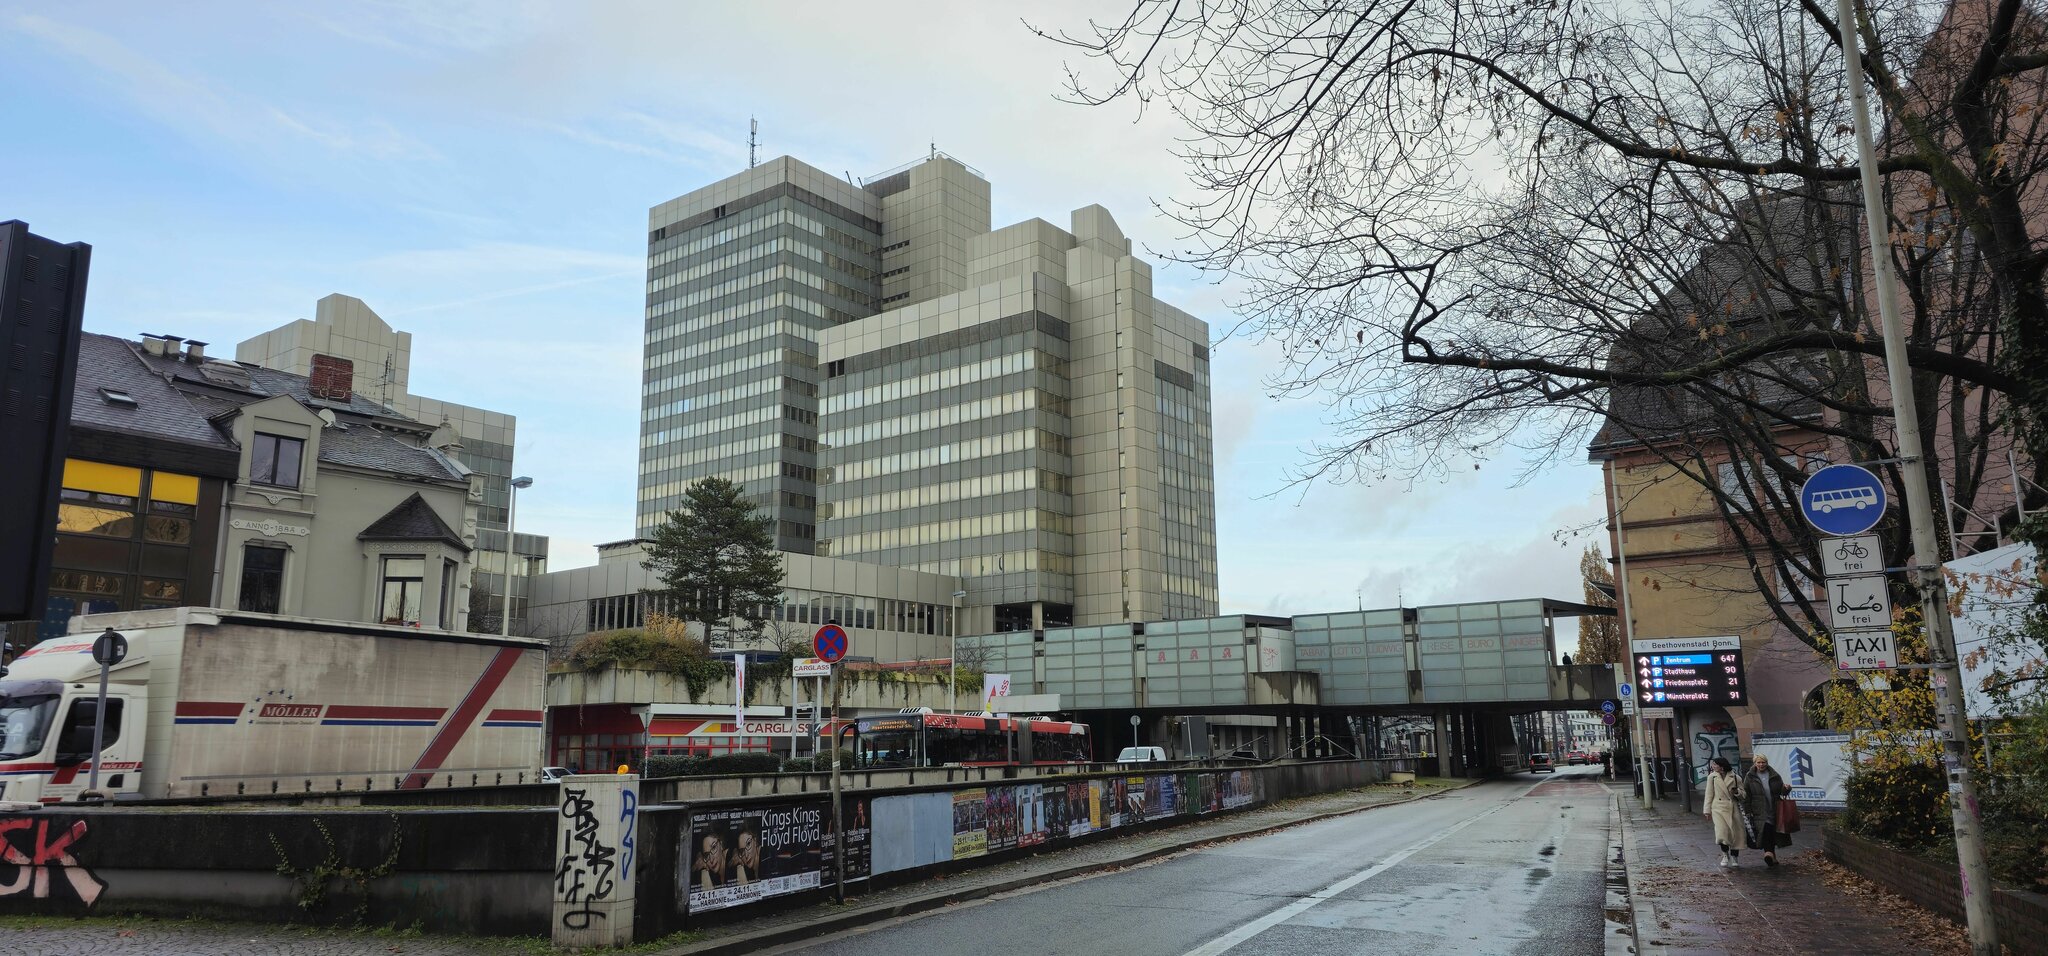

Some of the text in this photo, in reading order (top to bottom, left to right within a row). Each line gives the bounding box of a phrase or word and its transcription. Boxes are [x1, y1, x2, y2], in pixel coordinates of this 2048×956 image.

[1844, 561, 1863, 570] frei
[1852, 615, 1871, 624] frei
[1652, 640, 1710, 649] Beethovenstadt
[1845, 637, 1887, 652] TAXI
[1720, 654, 1736, 662] 647
[1857, 656, 1877, 665] frei
[793, 664, 830, 672] CARGLASS
[1724, 666, 1736, 674] 90
[1728, 677, 1738, 685] 21
[1666, 692, 1709, 700] Münsterplatz
[1729, 691, 1739, 699] 91
[1789, 790, 1826, 799] RETZER
[761, 809, 791, 830] Kings
[792, 806, 820, 828] Kings
[761, 826, 790, 850] Floyd
[792, 823, 820, 846] Floyd
[733, 885, 752, 895] 24.11.
[697, 891, 717, 901] 24.11.
